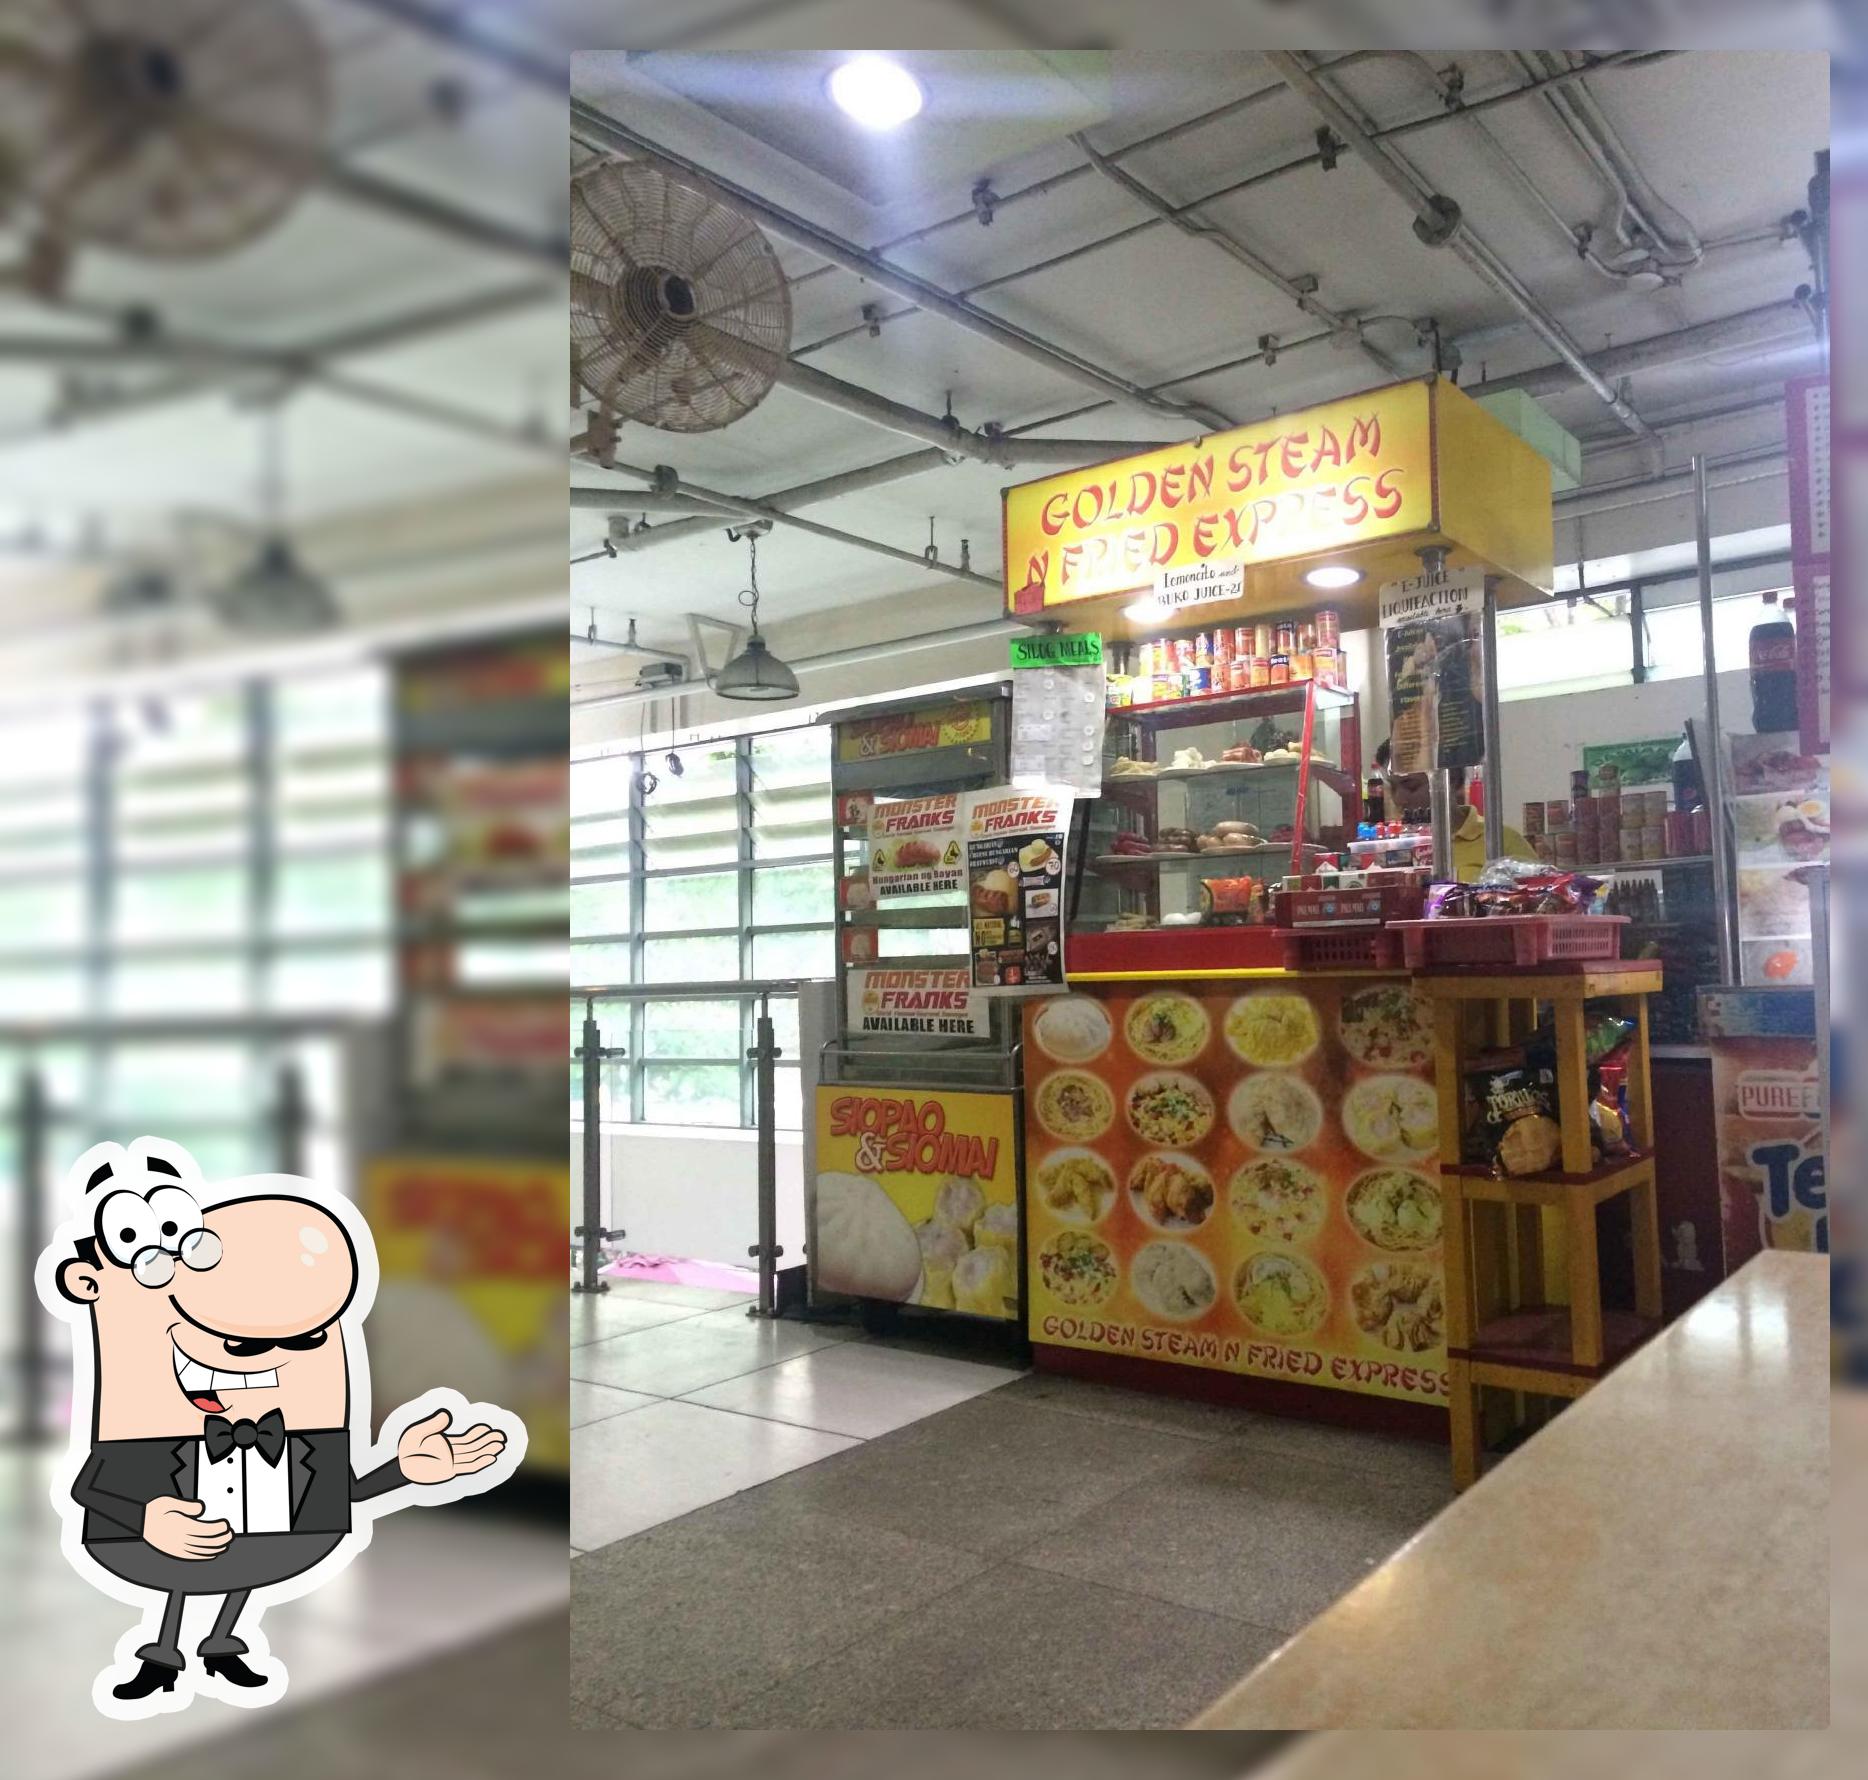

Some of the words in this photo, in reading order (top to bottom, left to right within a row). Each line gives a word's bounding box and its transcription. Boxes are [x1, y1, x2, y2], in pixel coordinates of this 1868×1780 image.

[1041, 454, 1213, 536] GOLDEN
[1227, 412, 1381, 493] STEAM
[1026, 551, 1050, 586] N
[1061, 522, 1179, 585] FED
[1193, 468, 1404, 558] EXPESS
[1164, 563, 1216, 588] Lemoncito
[1157, 590, 1190, 607] BUKO
[1060, 638, 1099, 657] MEALS
[874, 794, 958, 819] MONSTER
[885, 810, 955, 833] FRANKS
[984, 810, 1059, 833] FRANKS
[872, 870, 919, 885] Hungarian
[934, 868, 963, 880] Bayan
[880, 881, 931, 896] AVAILABLE
[933, 878, 958, 891] HERE
[864, 971, 970, 989] MONSTER
[881, 991, 969, 1010] FRANKS
[863, 1016, 935, 1032] AVAILABLE
[938, 1019, 975, 1034] HERE
[1742, 1085, 1820, 1108] PUREF
[830, 1096, 945, 1137] SIOPAO
[886, 1131, 999, 1181] SIOMAI
[1043, 1315, 1135, 1346] GOLDEN
[1141, 1328, 1217, 1360] STEAM
[1223, 1342, 1240, 1362] N
[1247, 1345, 1323, 1376] FRIED
[1331, 1356, 1449, 1397] EXPRESS
